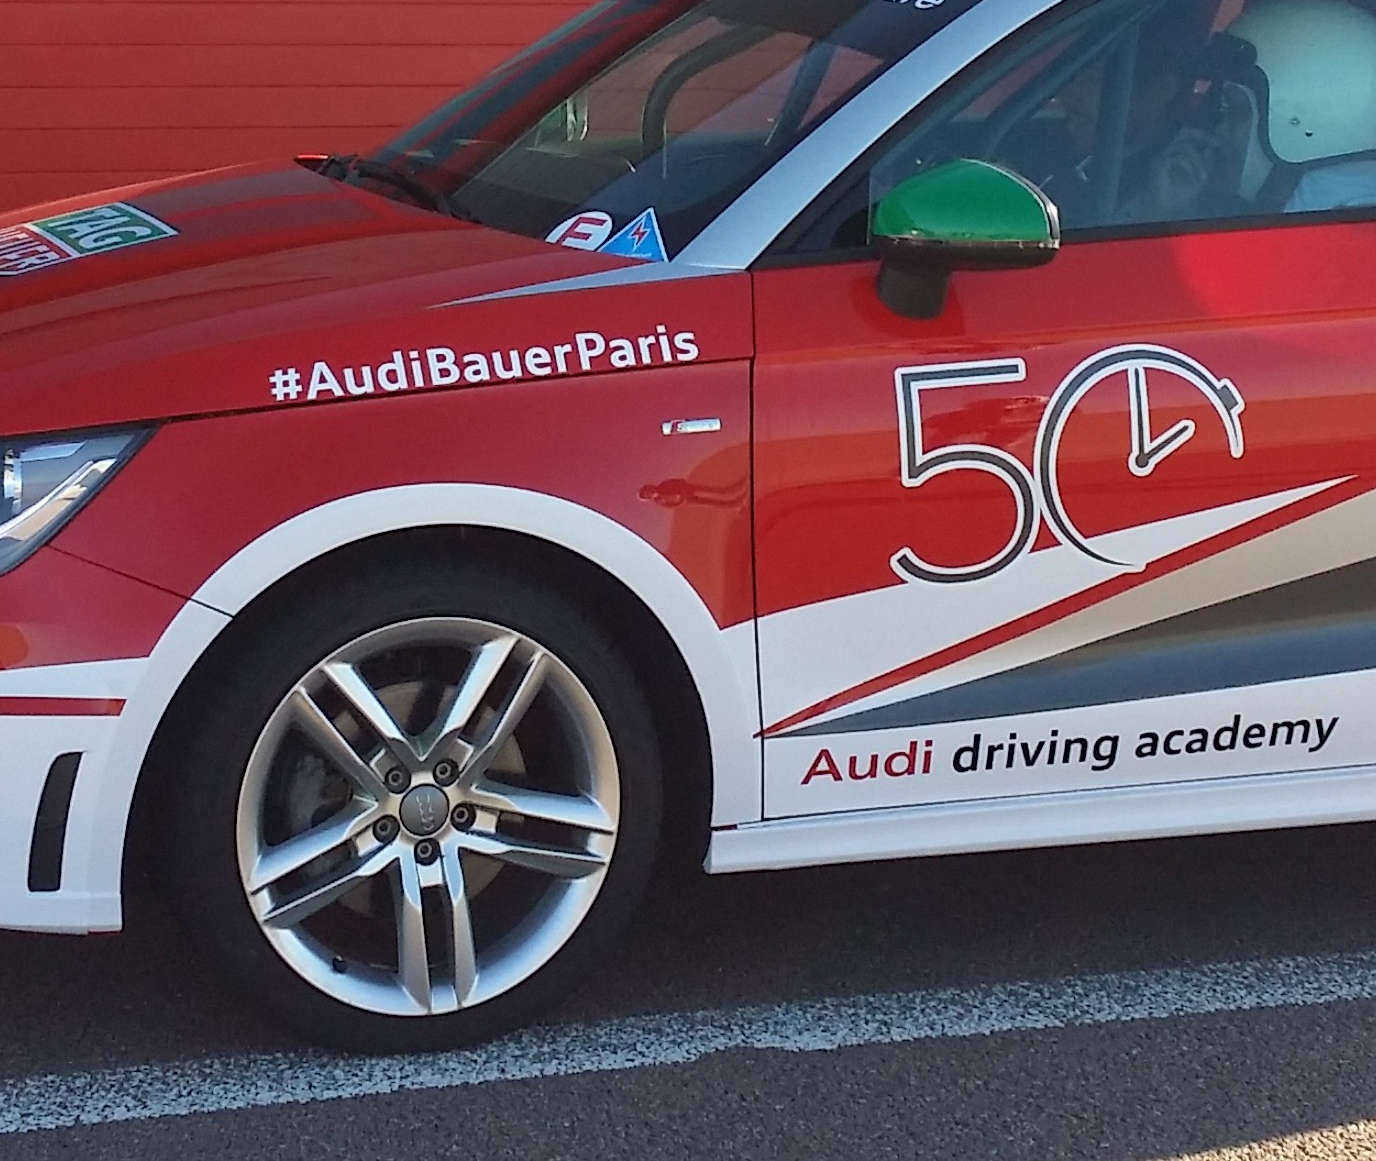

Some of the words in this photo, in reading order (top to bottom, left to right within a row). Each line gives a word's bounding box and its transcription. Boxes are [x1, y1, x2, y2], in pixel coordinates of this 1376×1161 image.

[48, 207, 153, 250] TAG
[269, 325, 700, 401] #AudiBauerParis
[801, 740, 933, 784] Audi
[951, 729, 1119, 772] driving
[1134, 714, 1340, 753] academy
